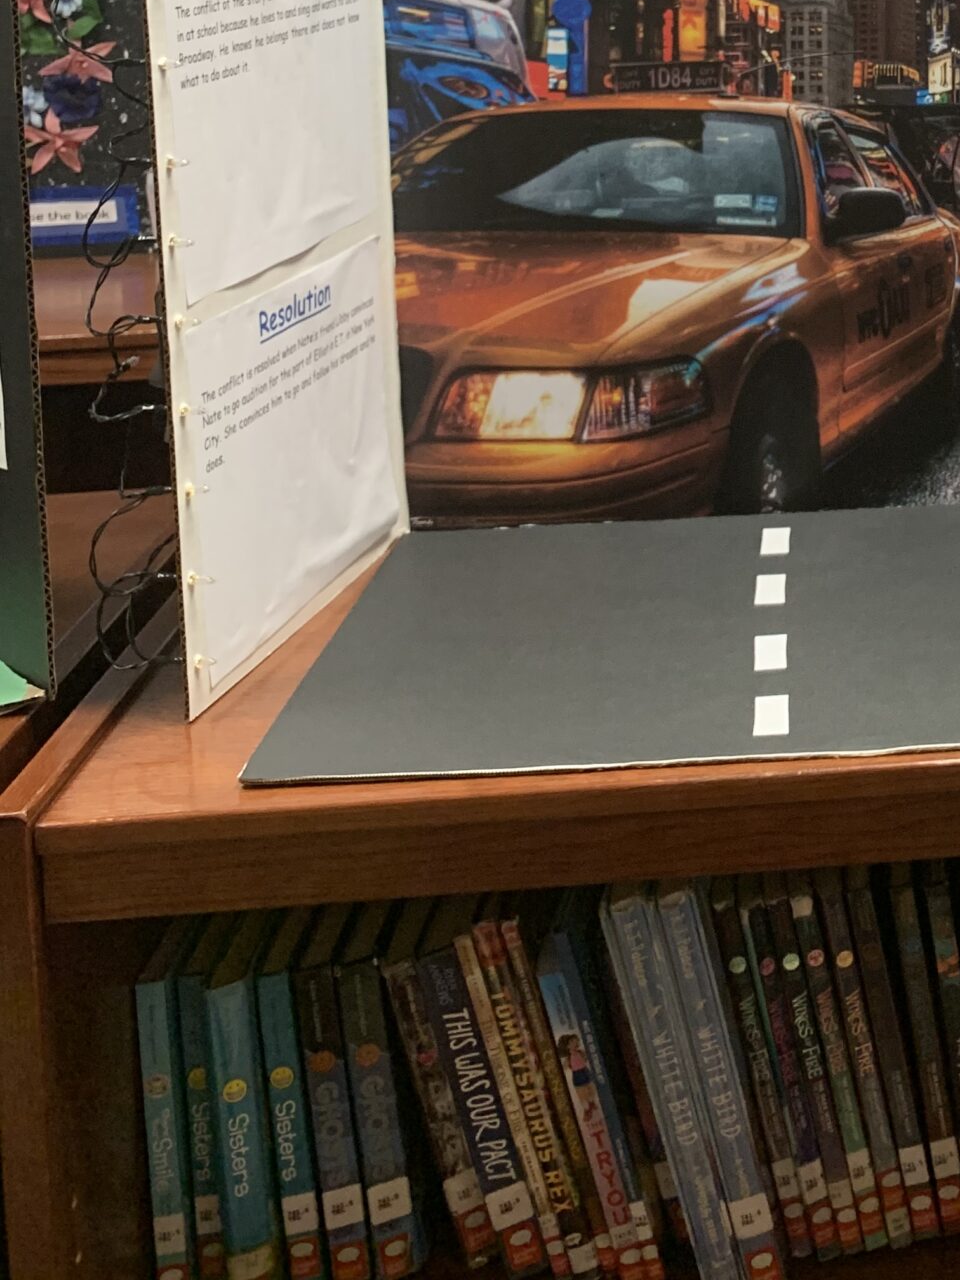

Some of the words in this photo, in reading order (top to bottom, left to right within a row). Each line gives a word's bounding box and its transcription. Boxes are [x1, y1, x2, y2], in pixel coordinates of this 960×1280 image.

[259, 285, 331, 337] Resolution
[442, 1007, 477, 1052] THIS
[792, 989, 814, 1039] WINGS
[845, 989, 868, 1036] WINGS
[453, 1054, 490, 1093] WAS
[801, 1043, 824, 1080] FIRE
[854, 1042, 875, 1077] FIRE
[466, 1090, 500, 1142] OUR
[228, 1112, 249, 1198] Sisters
[275, 1100, 297, 1182] Sisters
[480, 1137, 517, 1183] PACT
